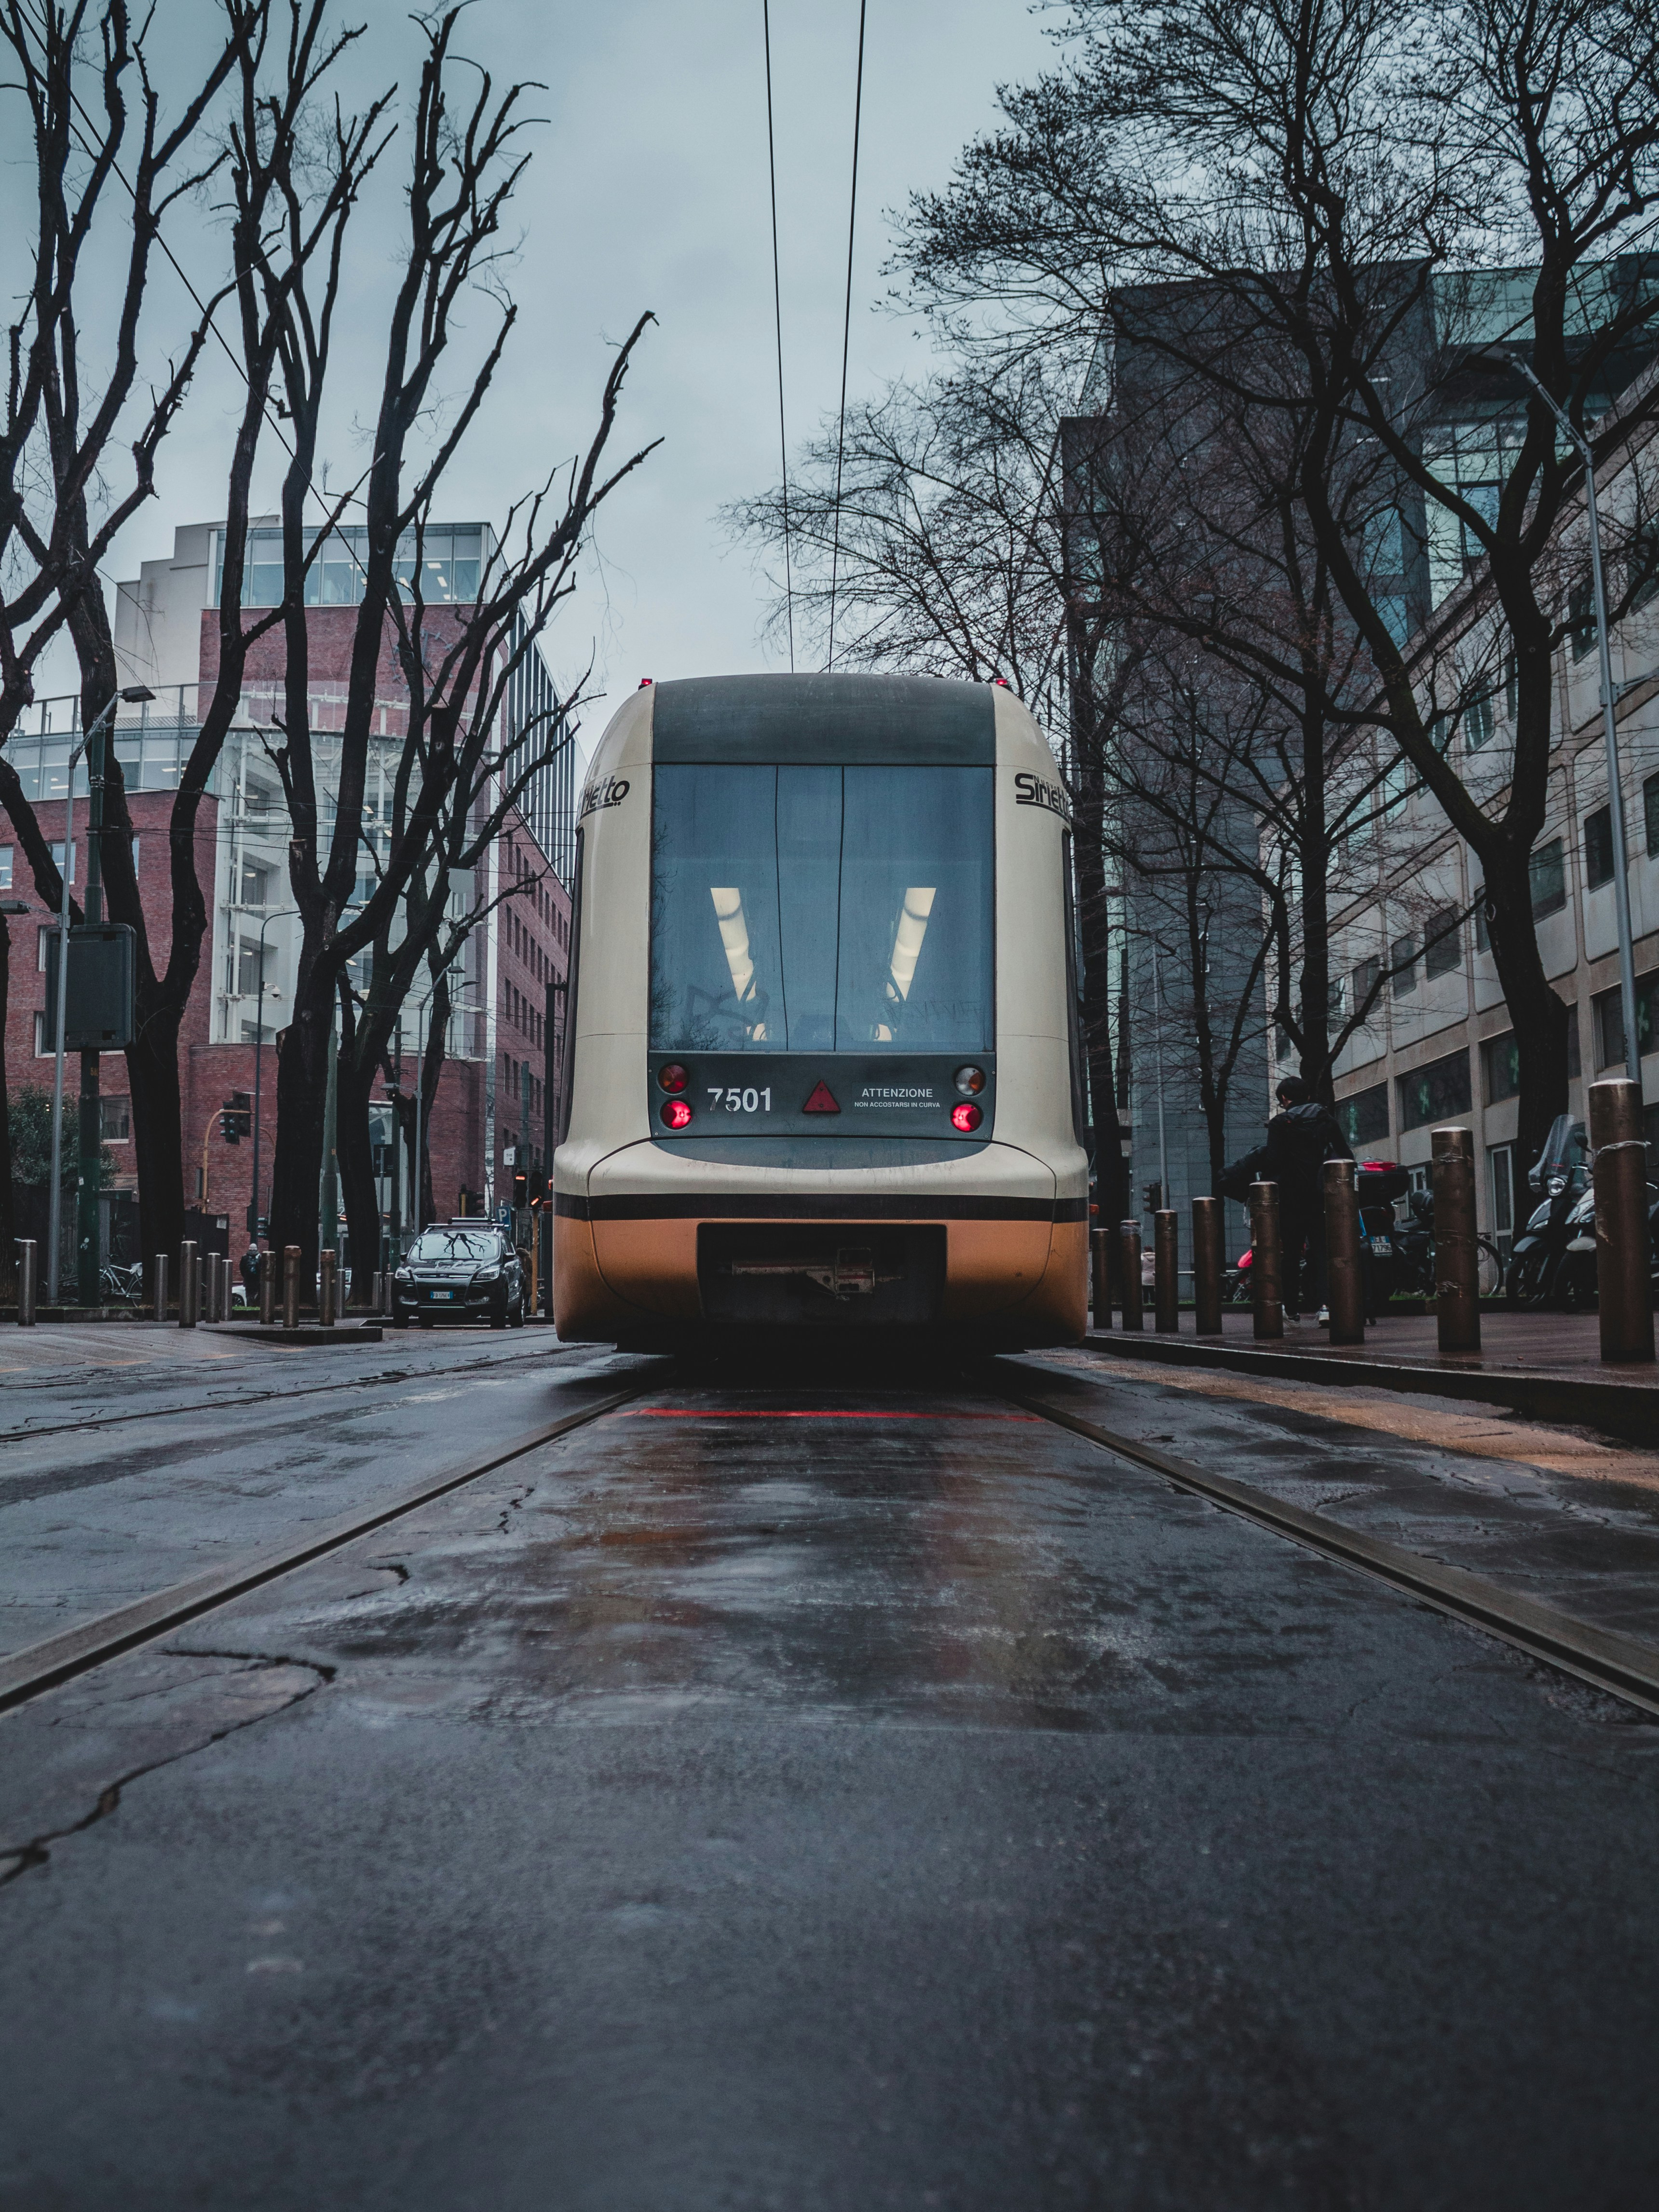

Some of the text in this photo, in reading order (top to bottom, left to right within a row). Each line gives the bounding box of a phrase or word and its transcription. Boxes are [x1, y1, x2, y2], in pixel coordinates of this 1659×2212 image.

[707, 1087, 770, 1112] 7501
[862, 1088, 933, 1097] ATTENZIONE
[498, 1208, 507, 1222] P
